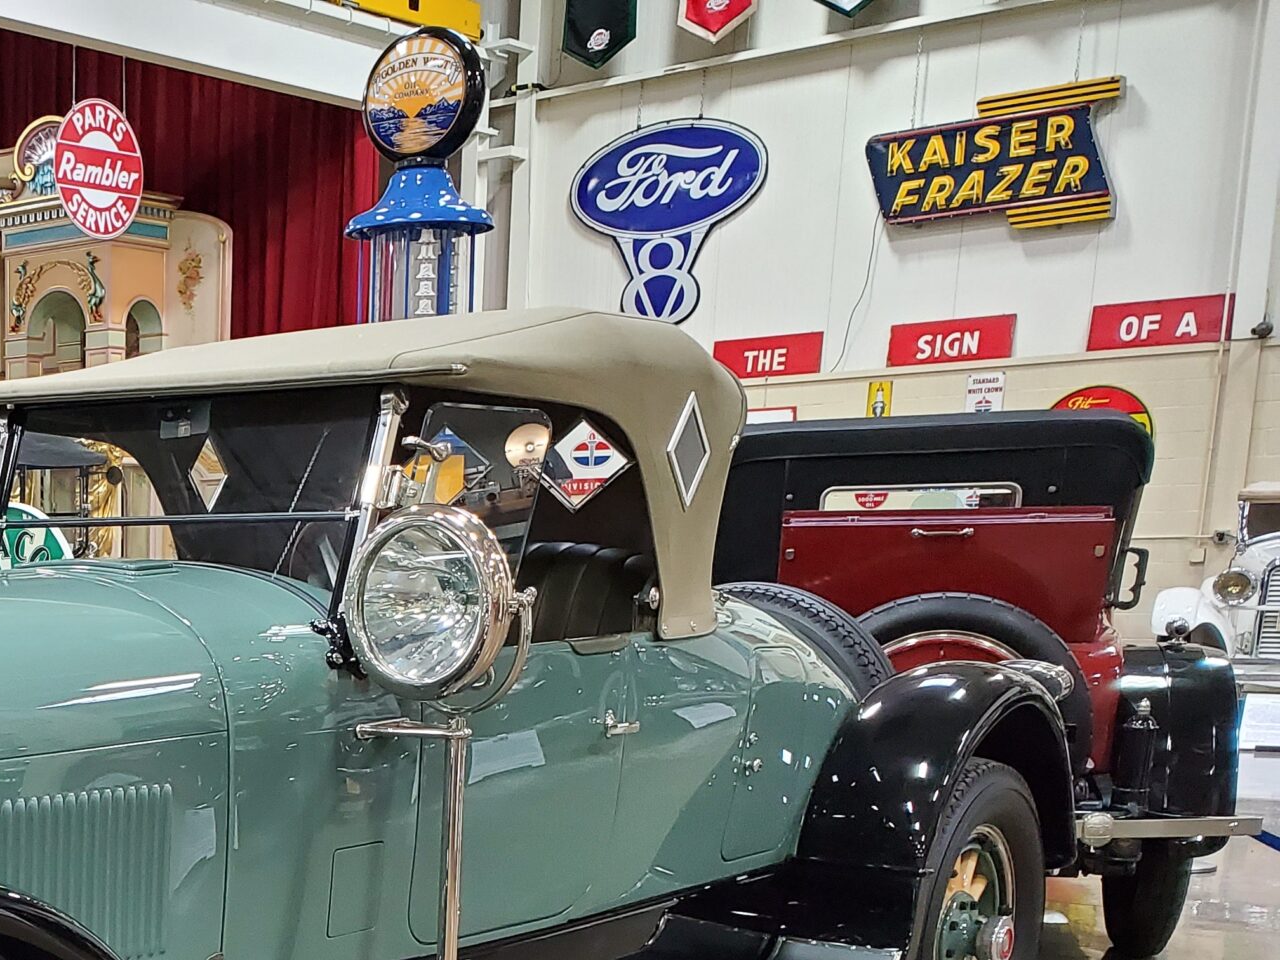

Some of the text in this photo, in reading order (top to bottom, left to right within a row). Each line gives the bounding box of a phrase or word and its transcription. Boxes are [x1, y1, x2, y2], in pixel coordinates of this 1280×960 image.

[381, 57, 418, 79] GOLDEN
[72, 105, 127, 142] PARTS
[887, 114, 1075, 176] KAISER
[58, 151, 139, 190] Rambler
[596, 143, 740, 212] Ford
[889, 155, 1090, 217] FRAZER
[68, 193, 130, 233] SERVICE
[916, 330, 981, 360] SIGN
[1119, 311, 1198, 342] OF A
[744, 348, 787, 373] THE
[972, 377, 1000, 385] STANDARD
